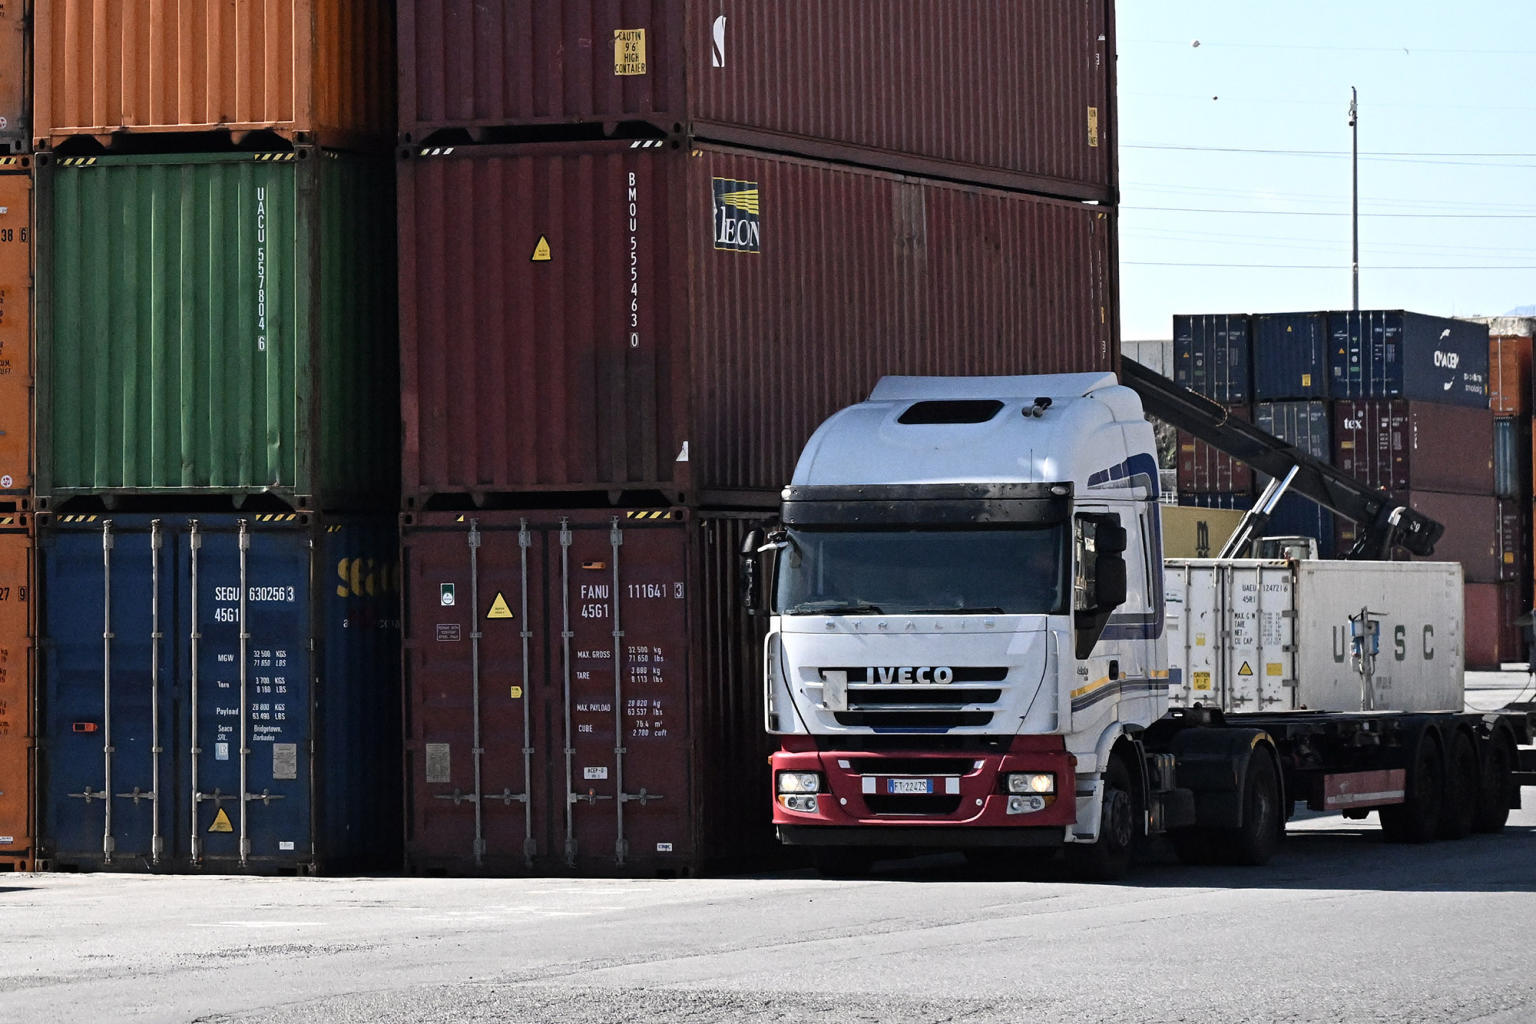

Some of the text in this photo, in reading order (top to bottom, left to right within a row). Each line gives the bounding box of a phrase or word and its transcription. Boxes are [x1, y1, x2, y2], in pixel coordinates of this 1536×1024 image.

[257, 187, 265, 243] UACU
[19, 228, 27, 242] 6
[258, 335, 265, 351] 6
[631, 332, 639, 348] 0
[1344, 417, 1362, 429] tex
[18, 587, 26, 601] 9
[215, 586, 295, 601] SEGU 630256 3
[581, 583, 683, 599] FANU 111641 3
[215, 608, 239, 622] 45G1
[581, 604, 609, 618] 45G1
[1332, 624, 1434, 662] USC
[218, 653, 234, 662] MGW
[276, 650, 287, 658] KGS
[654, 647, 662, 655] kg
[276, 659, 286, 667] LBS
[653, 667, 661, 675] kg
[866, 666, 954, 685] IVECO
[275, 677, 285, 685] KGS
[276, 686, 287, 694] LBS
[216, 707, 239, 716] Payload
[275, 703, 285, 711] KGS
[590, 703, 611, 711] PAYLOAD
[653, 700, 661, 708] kg
[275, 712, 286, 720] LBS
[579, 725, 592, 733] CUBE
